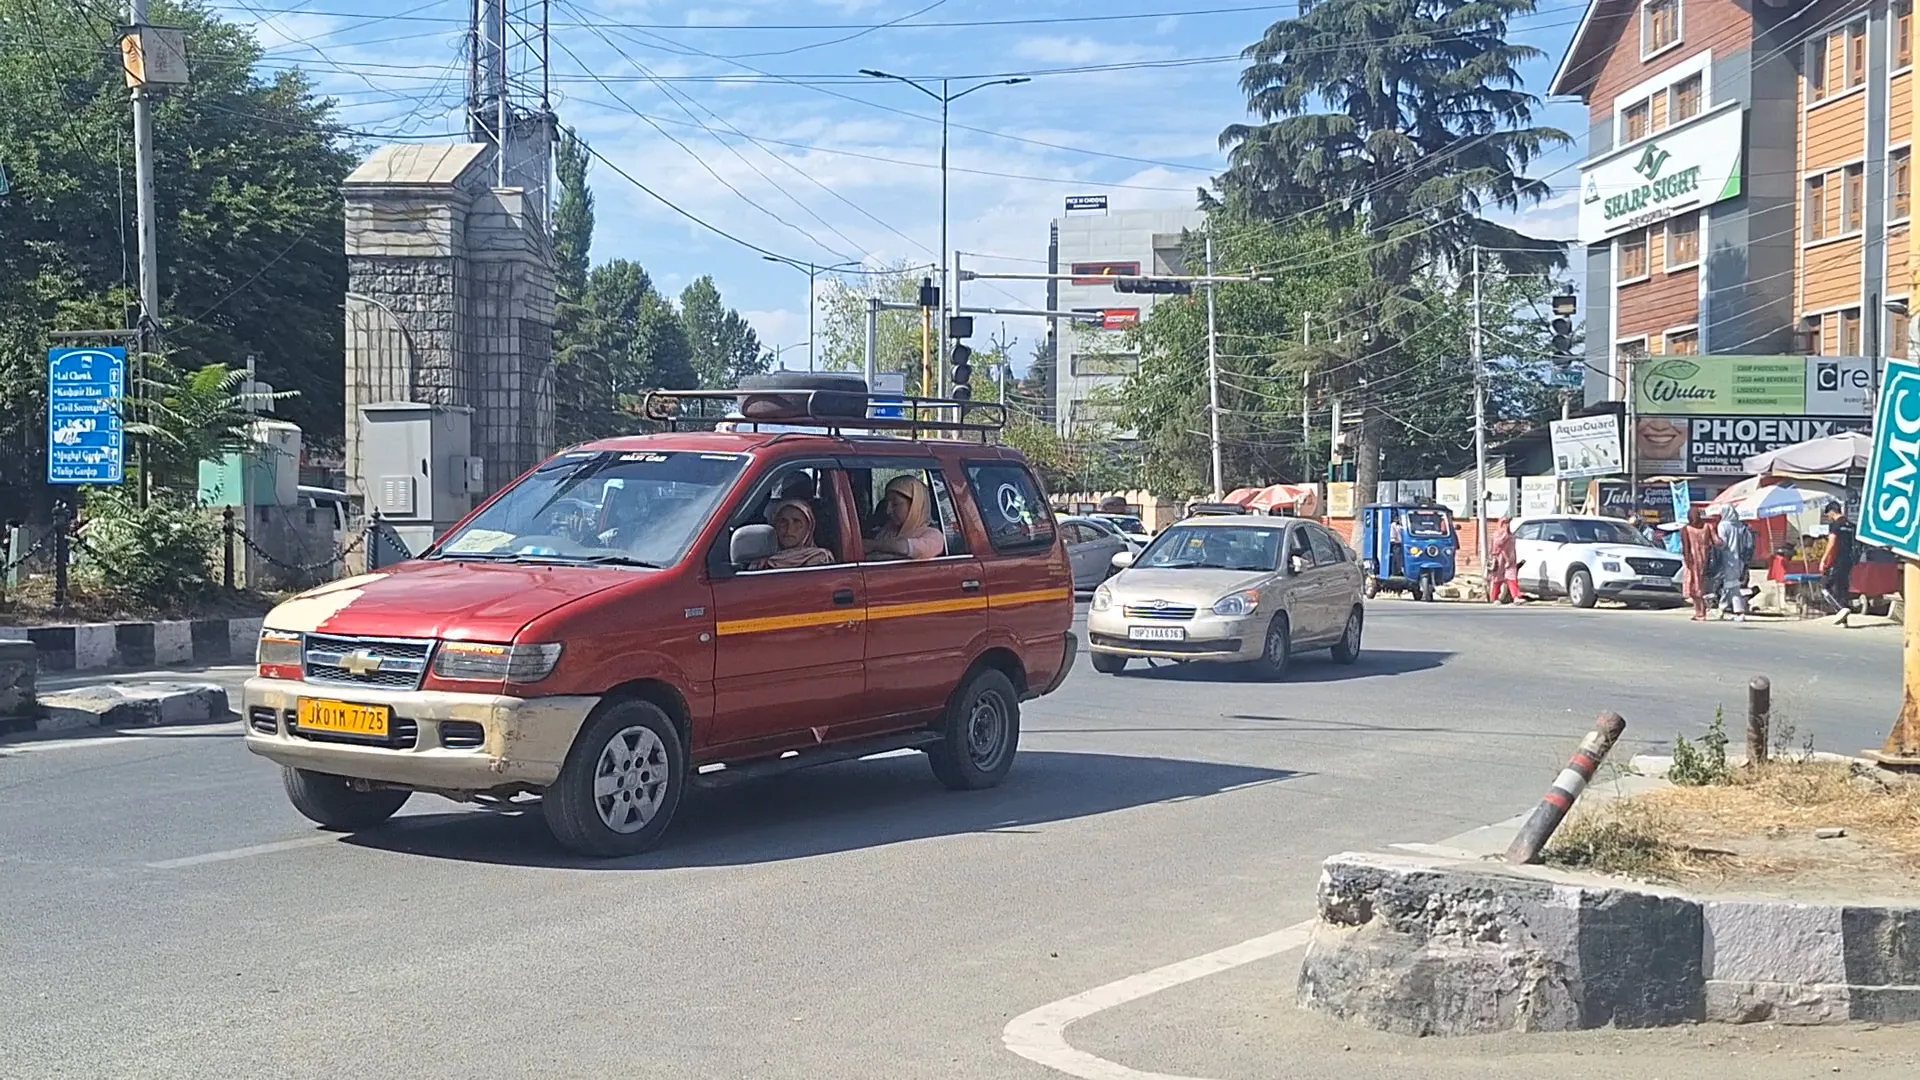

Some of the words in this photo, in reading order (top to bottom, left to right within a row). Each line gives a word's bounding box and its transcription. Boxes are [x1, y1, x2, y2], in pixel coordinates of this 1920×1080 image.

[1604, 184, 1652, 220] SHARP
[1653, 165, 1700, 204] SIGHT
[1652, 380, 1717, 401] Wular
[57, 403, 73, 412] Civil
[1555, 418, 1615, 435] AquaGuard
[1692, 420, 1832, 442] PHOENIX
[1692, 442, 1760, 456] DENTAL
[1879, 388, 1920, 528] SMC
[1692, 456, 1728, 465] Catering
[308, 704, 346, 727] JK01M
[351, 709, 384, 730] 7725
